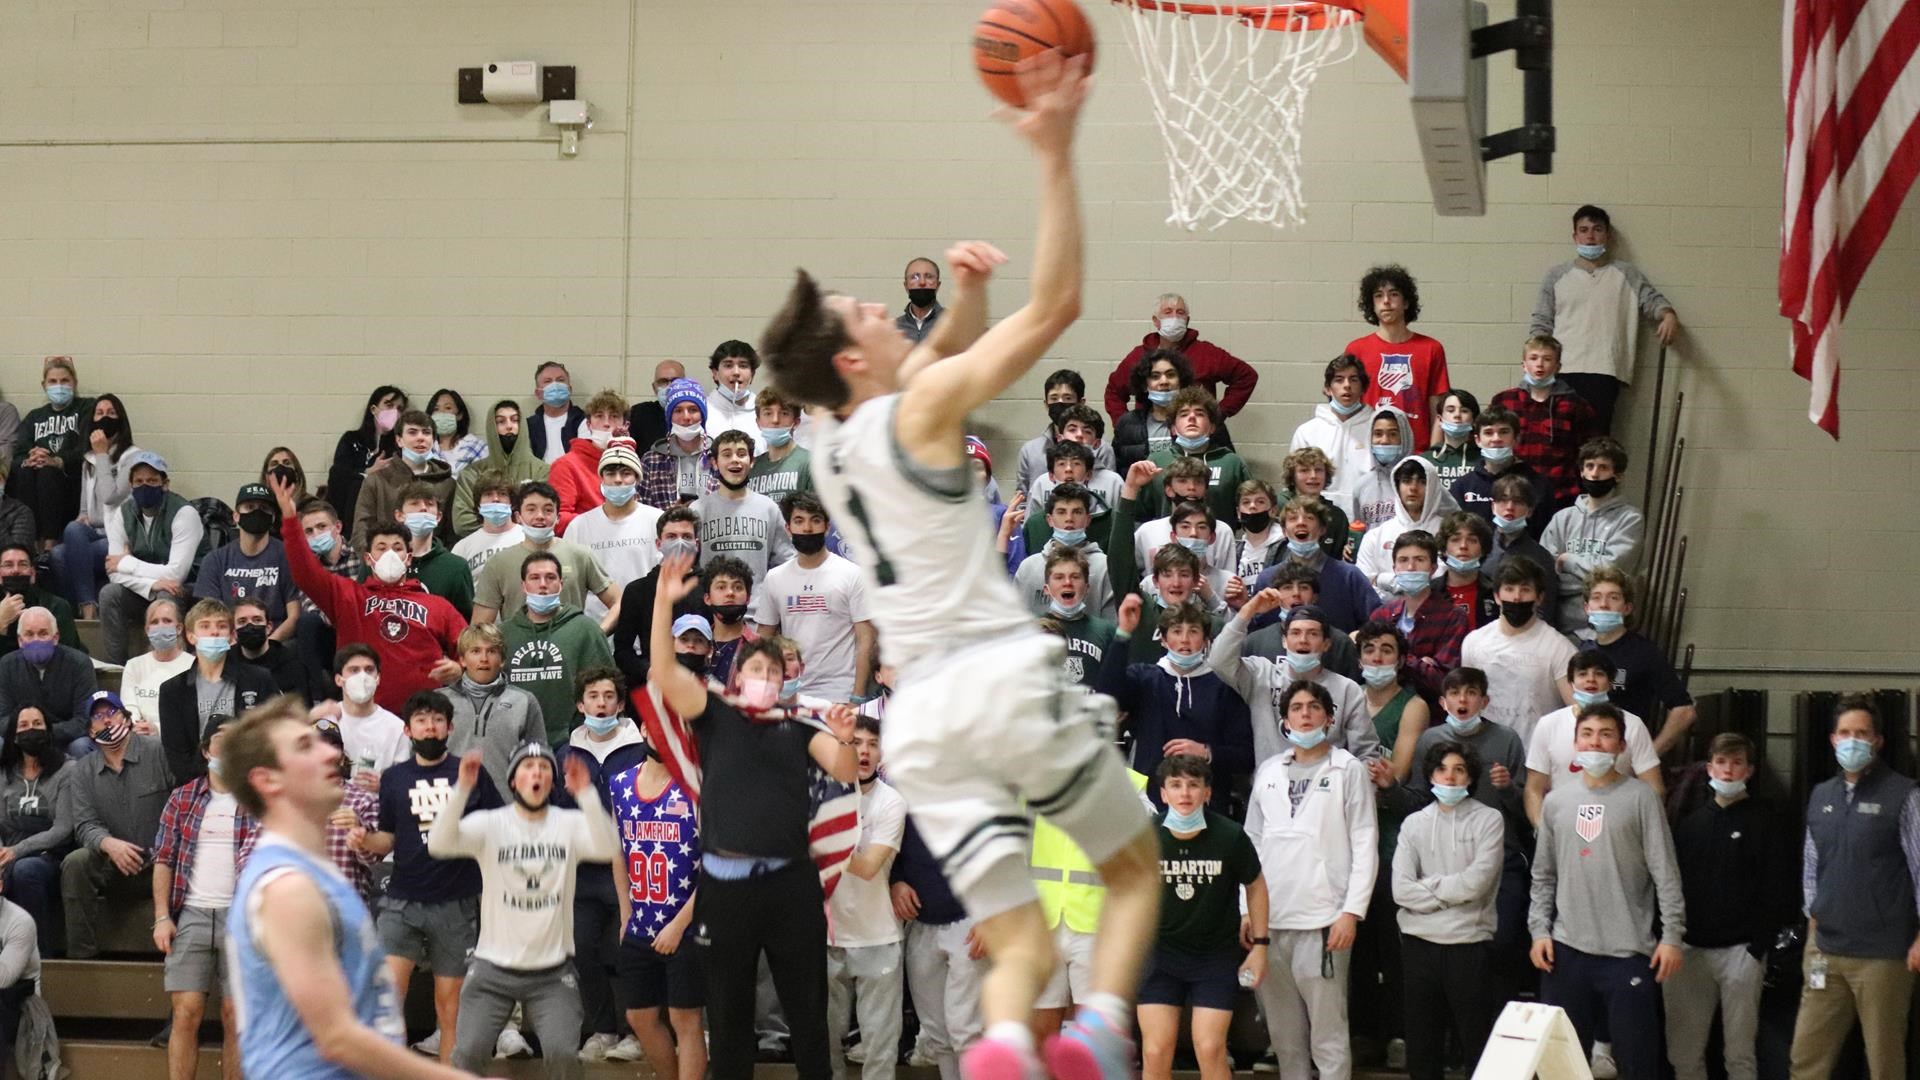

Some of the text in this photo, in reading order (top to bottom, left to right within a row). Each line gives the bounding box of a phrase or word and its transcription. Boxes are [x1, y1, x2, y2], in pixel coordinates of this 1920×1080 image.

[715, 540, 757, 550] BASKETBALL
[223, 566, 280, 578] AUTHENTIC
[255, 575, 279, 588] FAN
[364, 595, 429, 627] PENN
[510, 670, 563, 683] GREEN WAVE
[636, 820, 681, 842] AMERICA
[628, 850, 669, 904] 99
